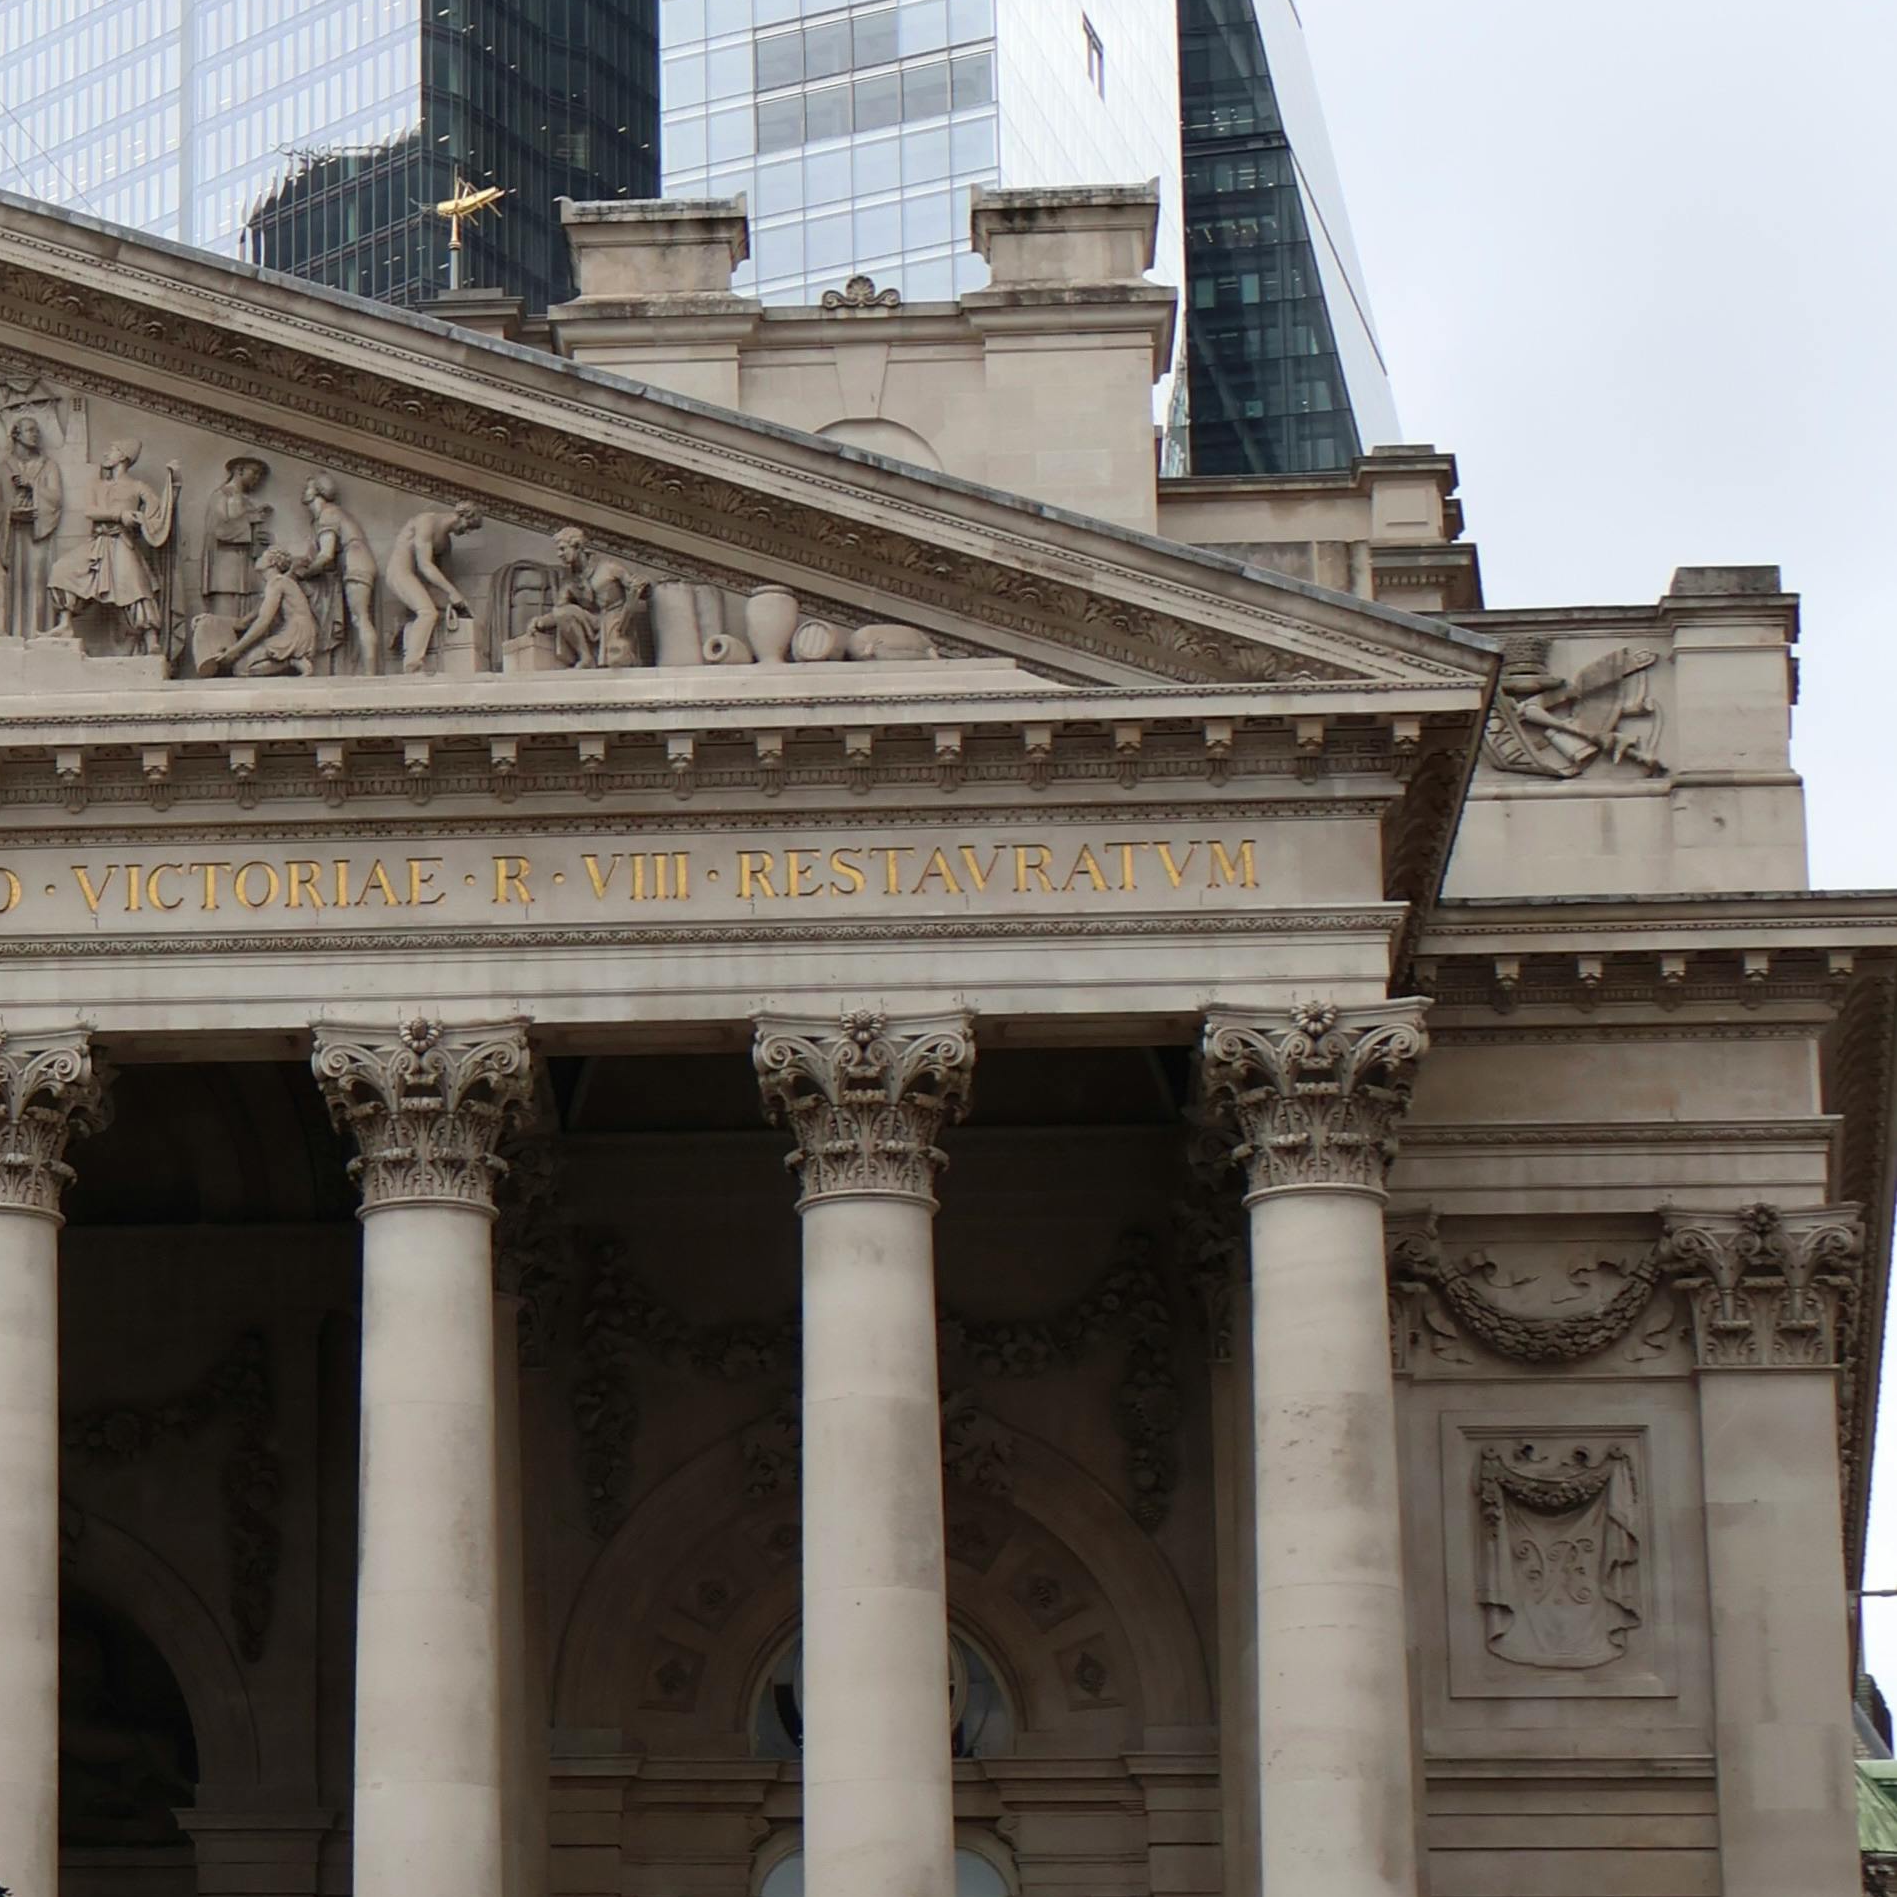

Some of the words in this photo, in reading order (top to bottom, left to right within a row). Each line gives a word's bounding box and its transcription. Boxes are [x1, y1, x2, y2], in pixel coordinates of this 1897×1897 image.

[70, 857, 446, 914] VICTORIAE
[492, 855, 535, 903] R
[580, 851, 690, 901] VIII
[735, 839, 1260, 899] RESTAVRATVM
